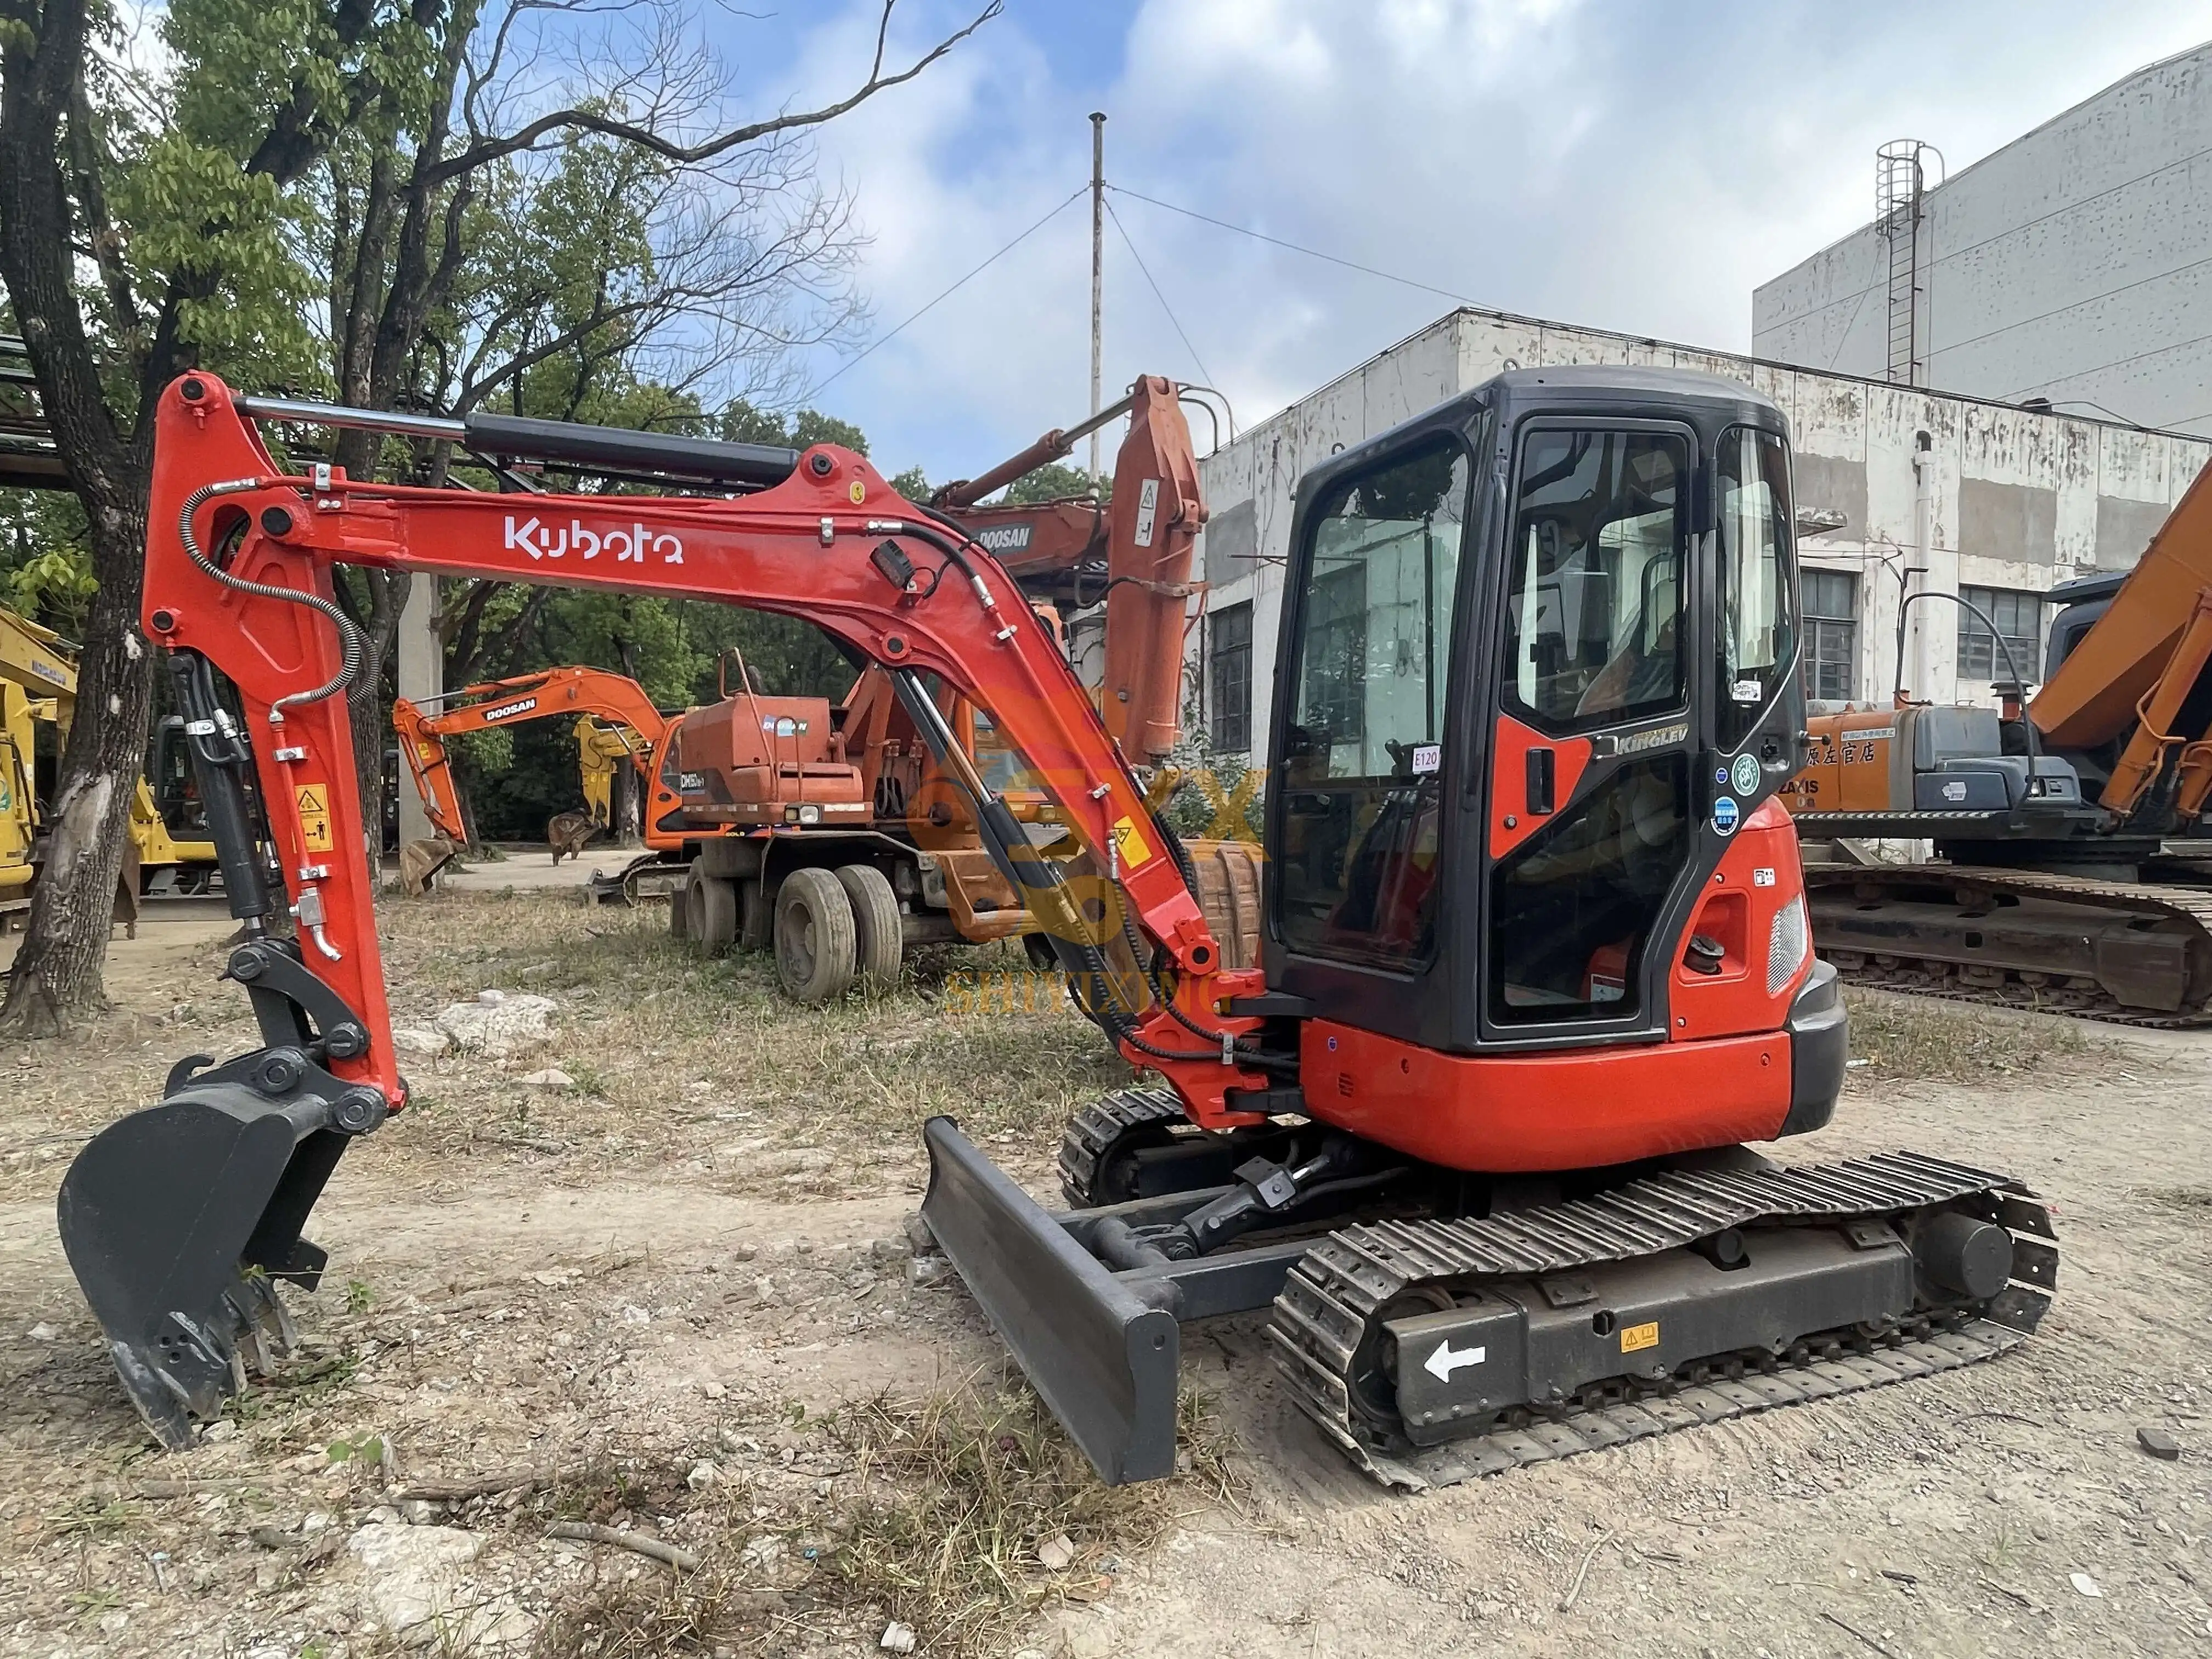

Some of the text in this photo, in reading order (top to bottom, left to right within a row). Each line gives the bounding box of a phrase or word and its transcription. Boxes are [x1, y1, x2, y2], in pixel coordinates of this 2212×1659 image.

[505, 516, 684, 564] Kubota
[980, 528, 1030, 549] DOOSAN
[487, 699, 535, 721] DOOSAN
[1415, 752, 1437, 766] E120
